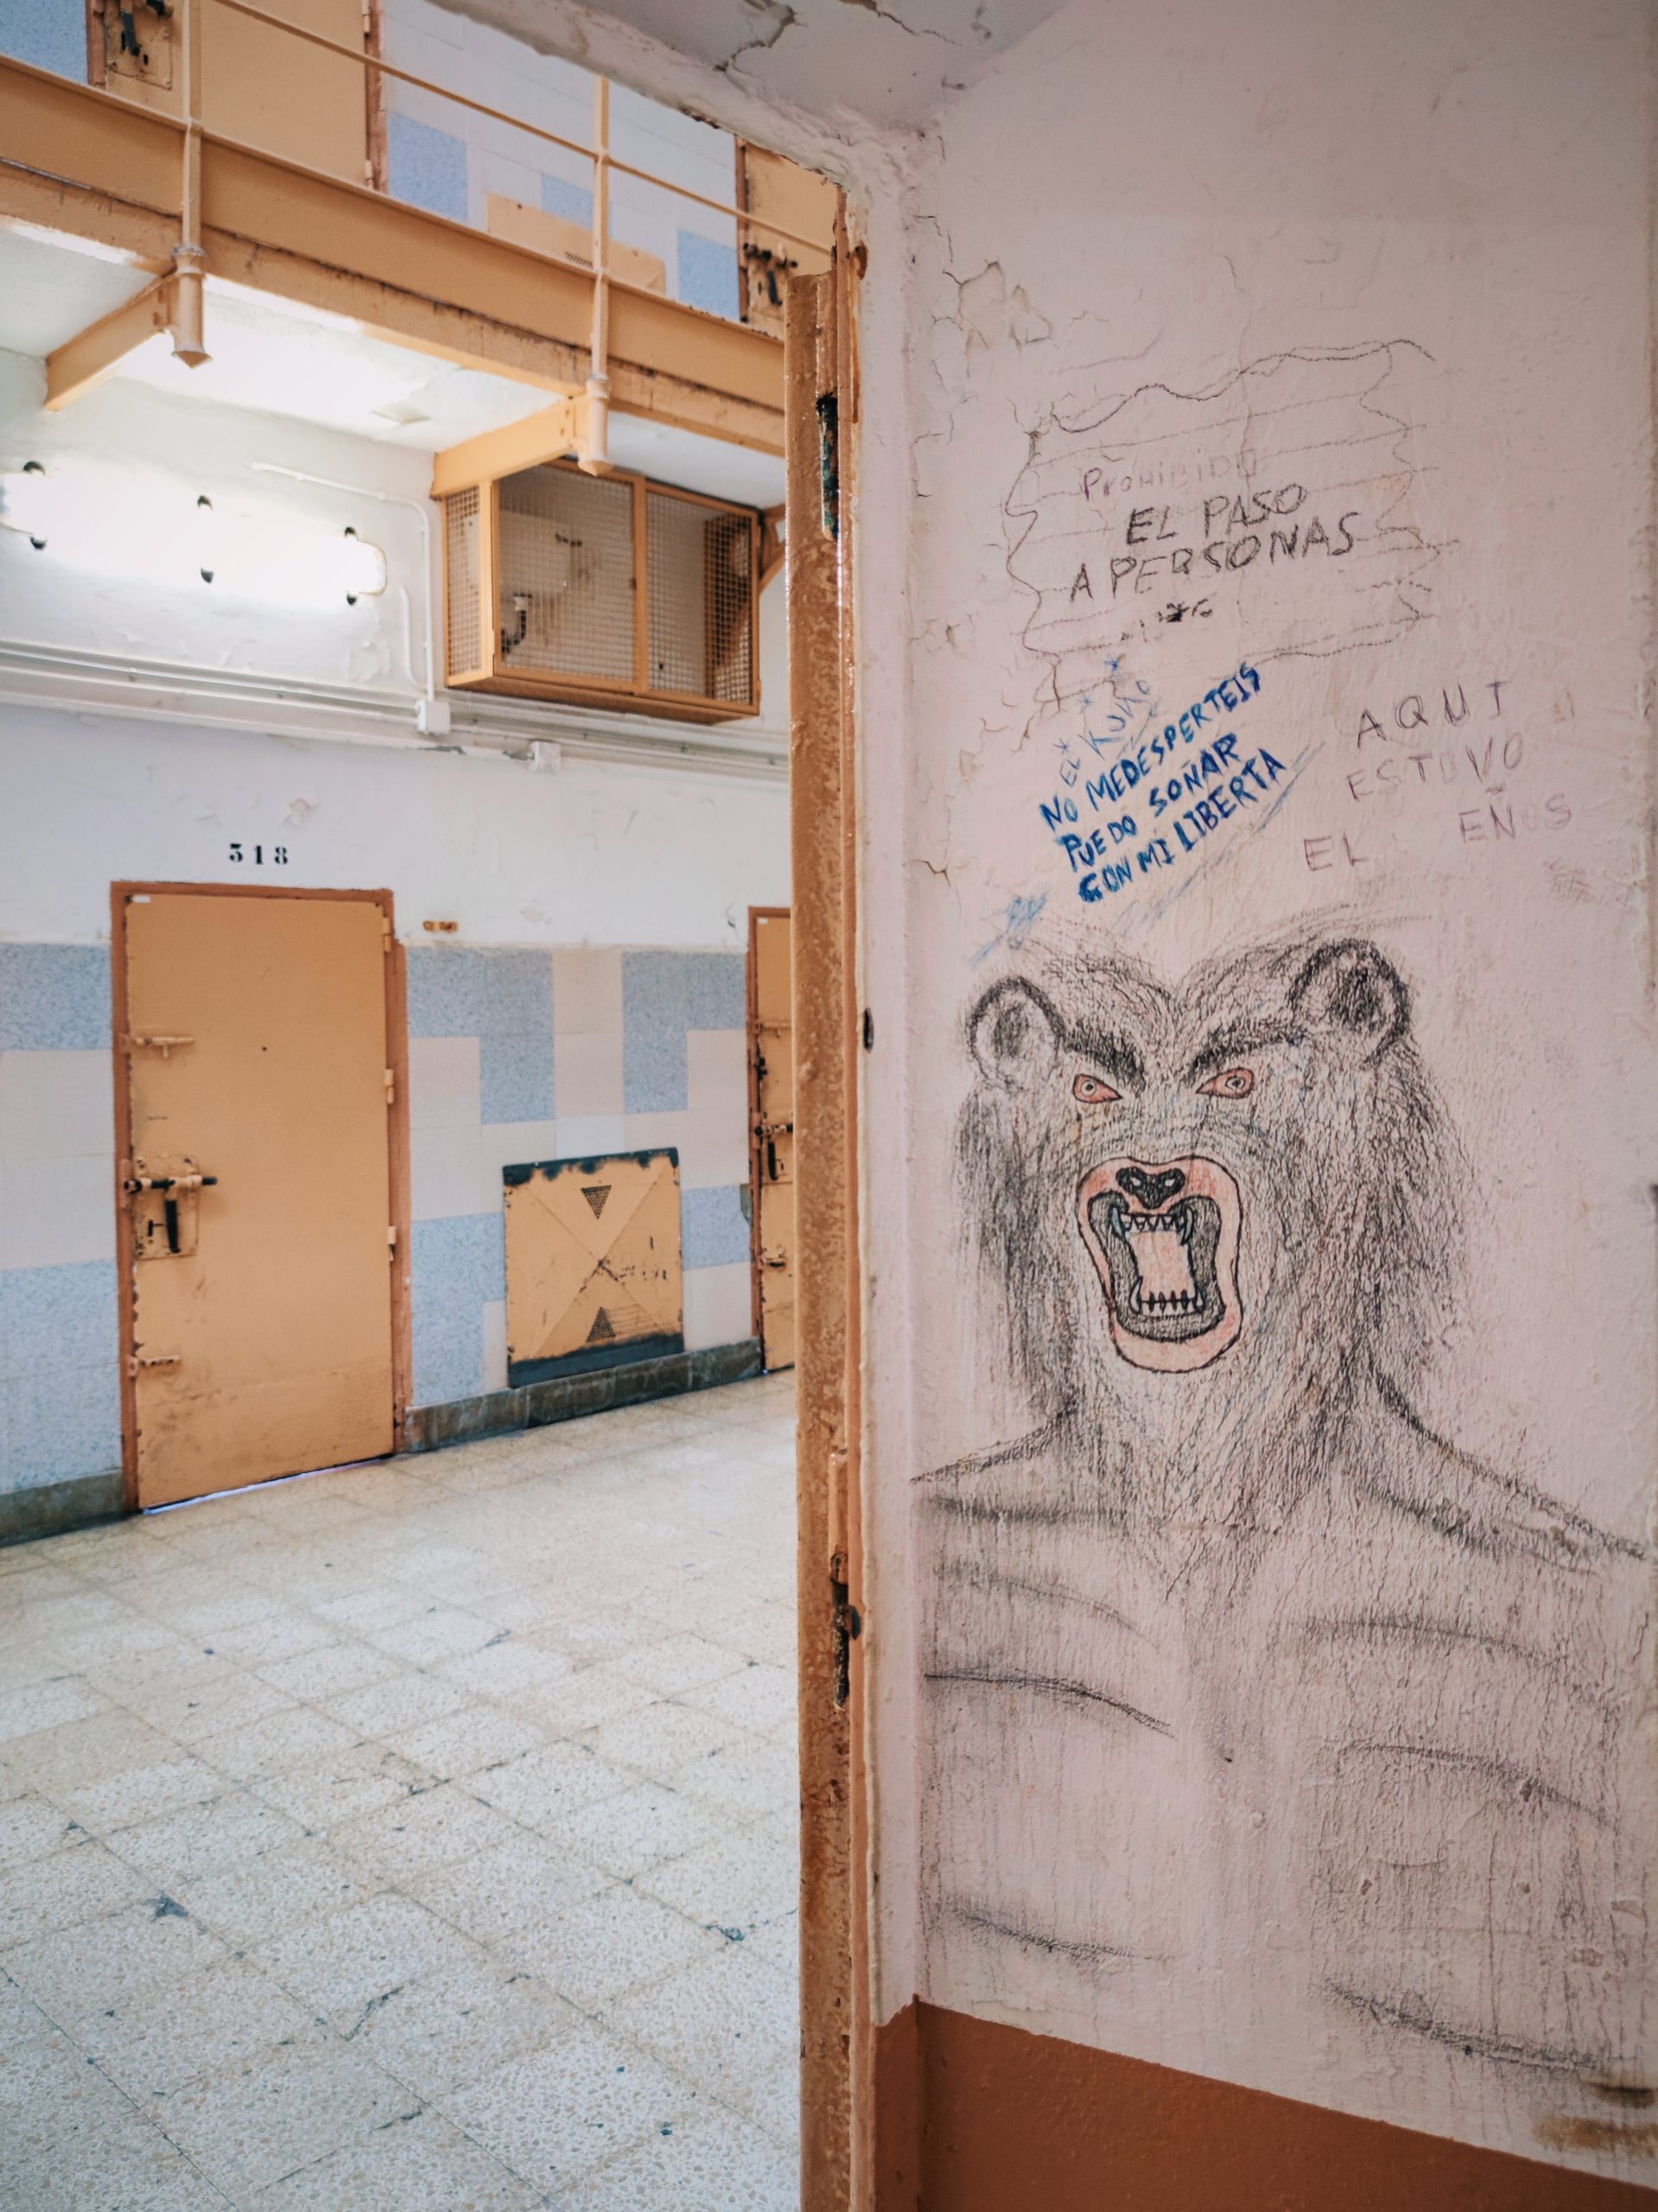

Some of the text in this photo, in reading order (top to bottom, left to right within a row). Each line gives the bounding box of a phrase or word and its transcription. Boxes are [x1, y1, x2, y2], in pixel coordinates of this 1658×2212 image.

[1126, 482, 1307, 545] EL PASO
[1070, 512, 1359, 601] A PERSONAS
[1357, 681, 1511, 748] AQUI
[1039, 795, 1078, 832] NO
[1136, 837, 1175, 873] MI
[1172, 747, 1286, 852] LIBERTA
[1303, 833, 1369, 872] EL
